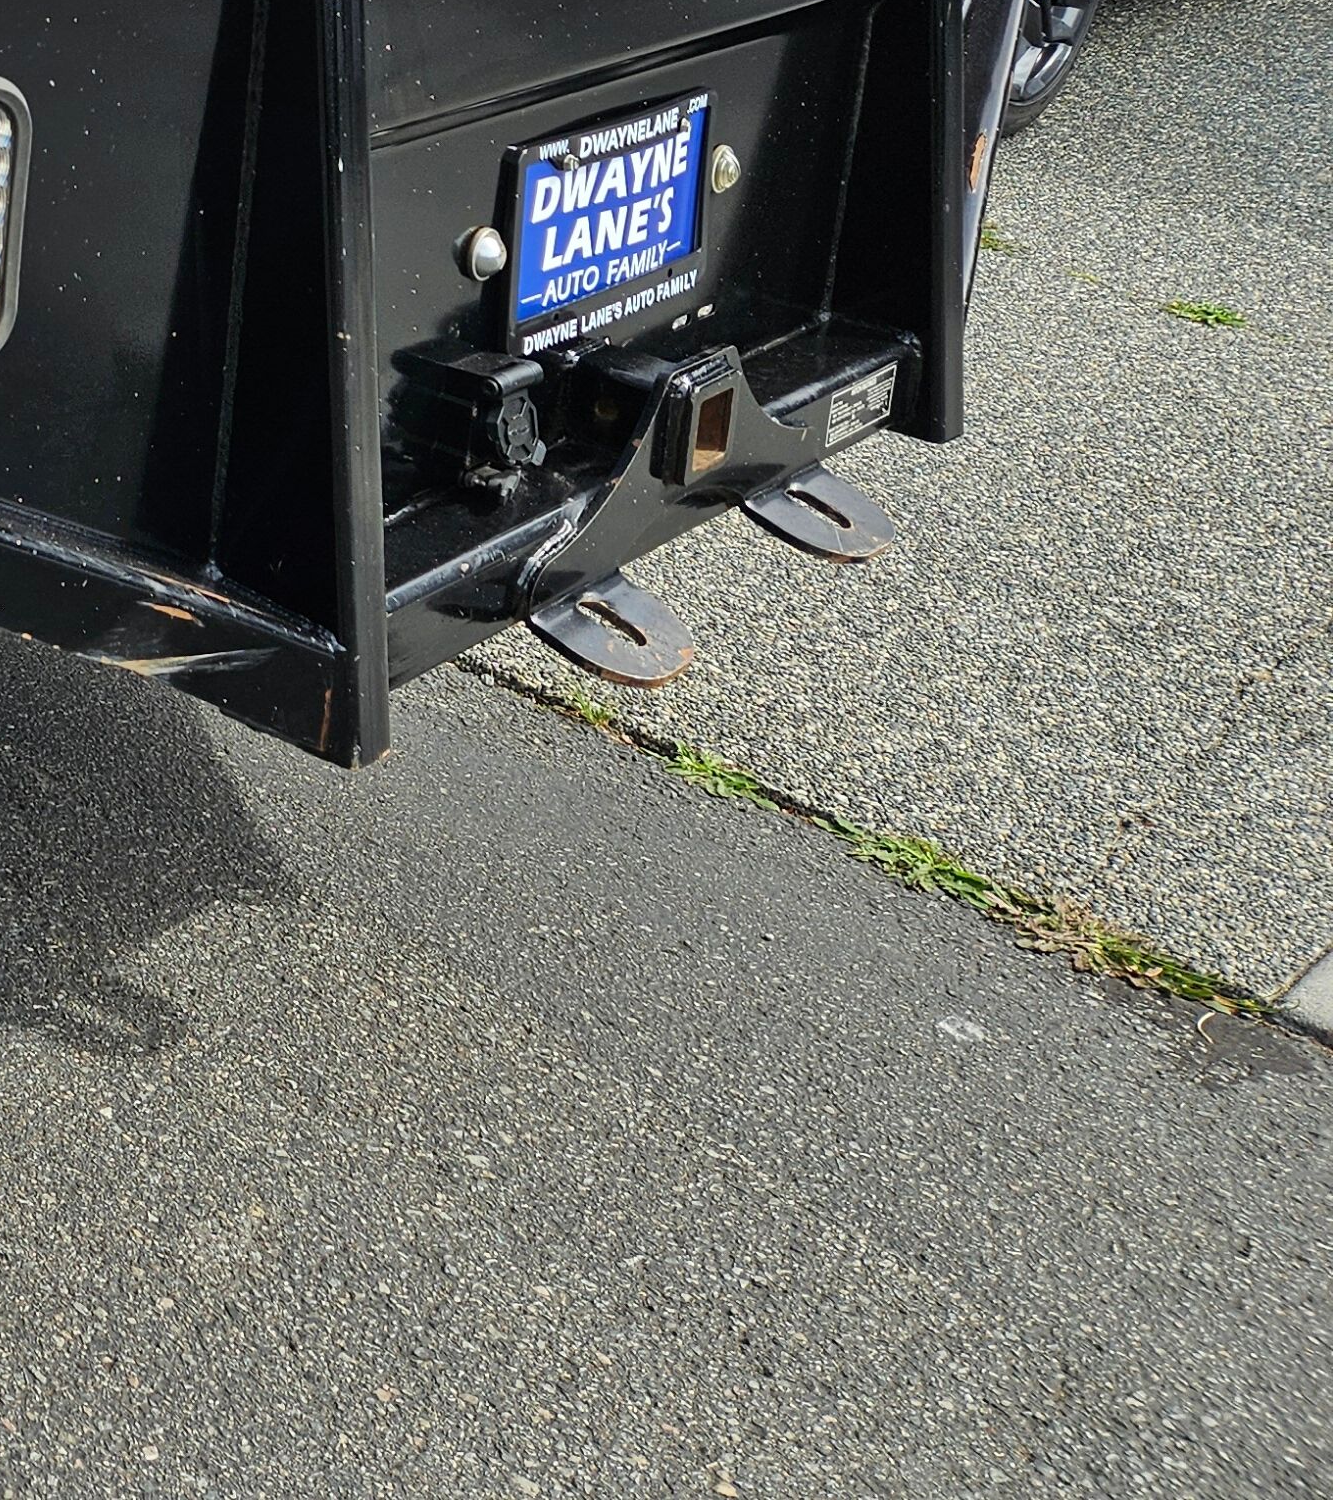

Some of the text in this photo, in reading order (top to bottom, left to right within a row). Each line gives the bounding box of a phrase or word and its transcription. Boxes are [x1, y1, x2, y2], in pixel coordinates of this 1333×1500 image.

[579, 106, 681, 159] DWAYNELANE
[531, 132, 692, 224] DWAYNE
[541, 186, 675, 272] LANE'S
[522, 268, 698, 356] DWAYNE LANE'S AUTO FAMILY
[541, 238, 668, 307] AUTO FAMILY
